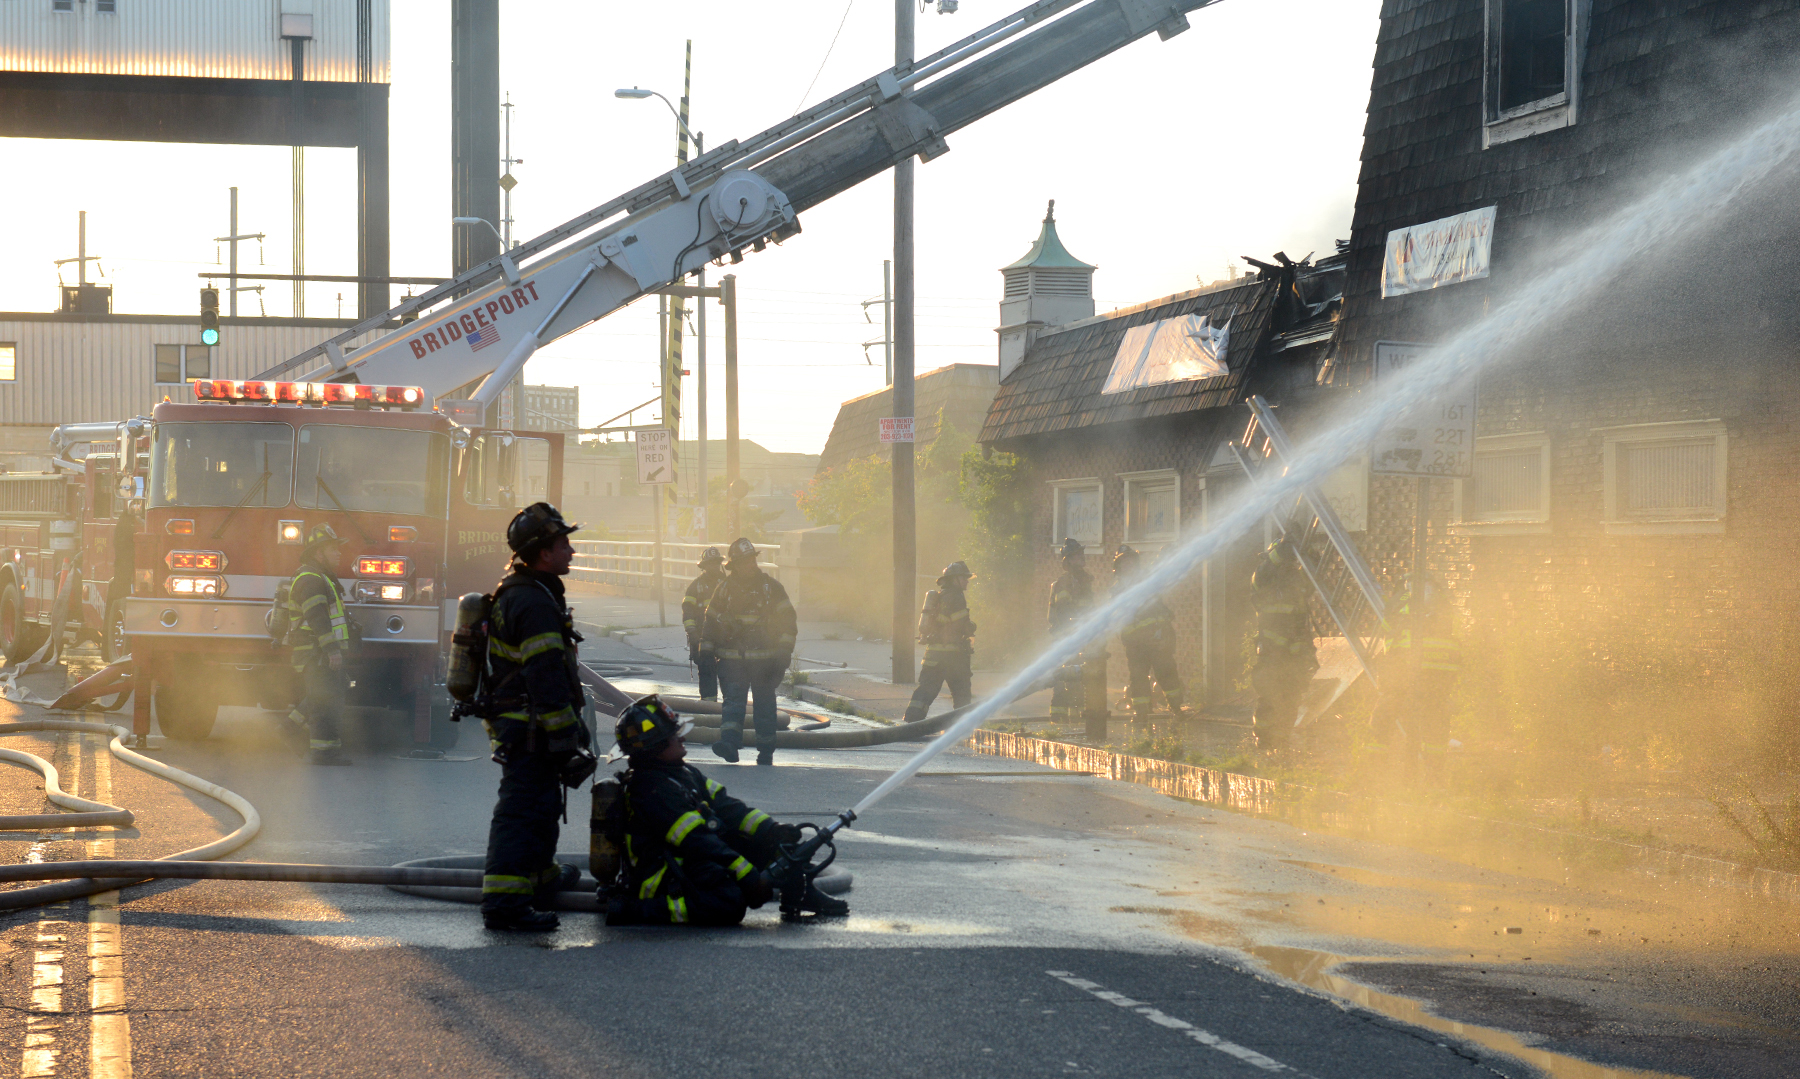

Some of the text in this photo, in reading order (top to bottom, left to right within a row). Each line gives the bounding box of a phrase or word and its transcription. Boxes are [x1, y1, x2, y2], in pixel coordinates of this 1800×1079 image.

[408, 280, 540, 360] BRIDGEPORT
[1442, 403, 1467, 420] 16T
[640, 432, 666, 442] STOP
[1433, 428, 1467, 446] 22T
[645, 453, 664, 463] RED
[458, 530, 508, 545] BRIDGE
[465, 544, 496, 561] FIRE
